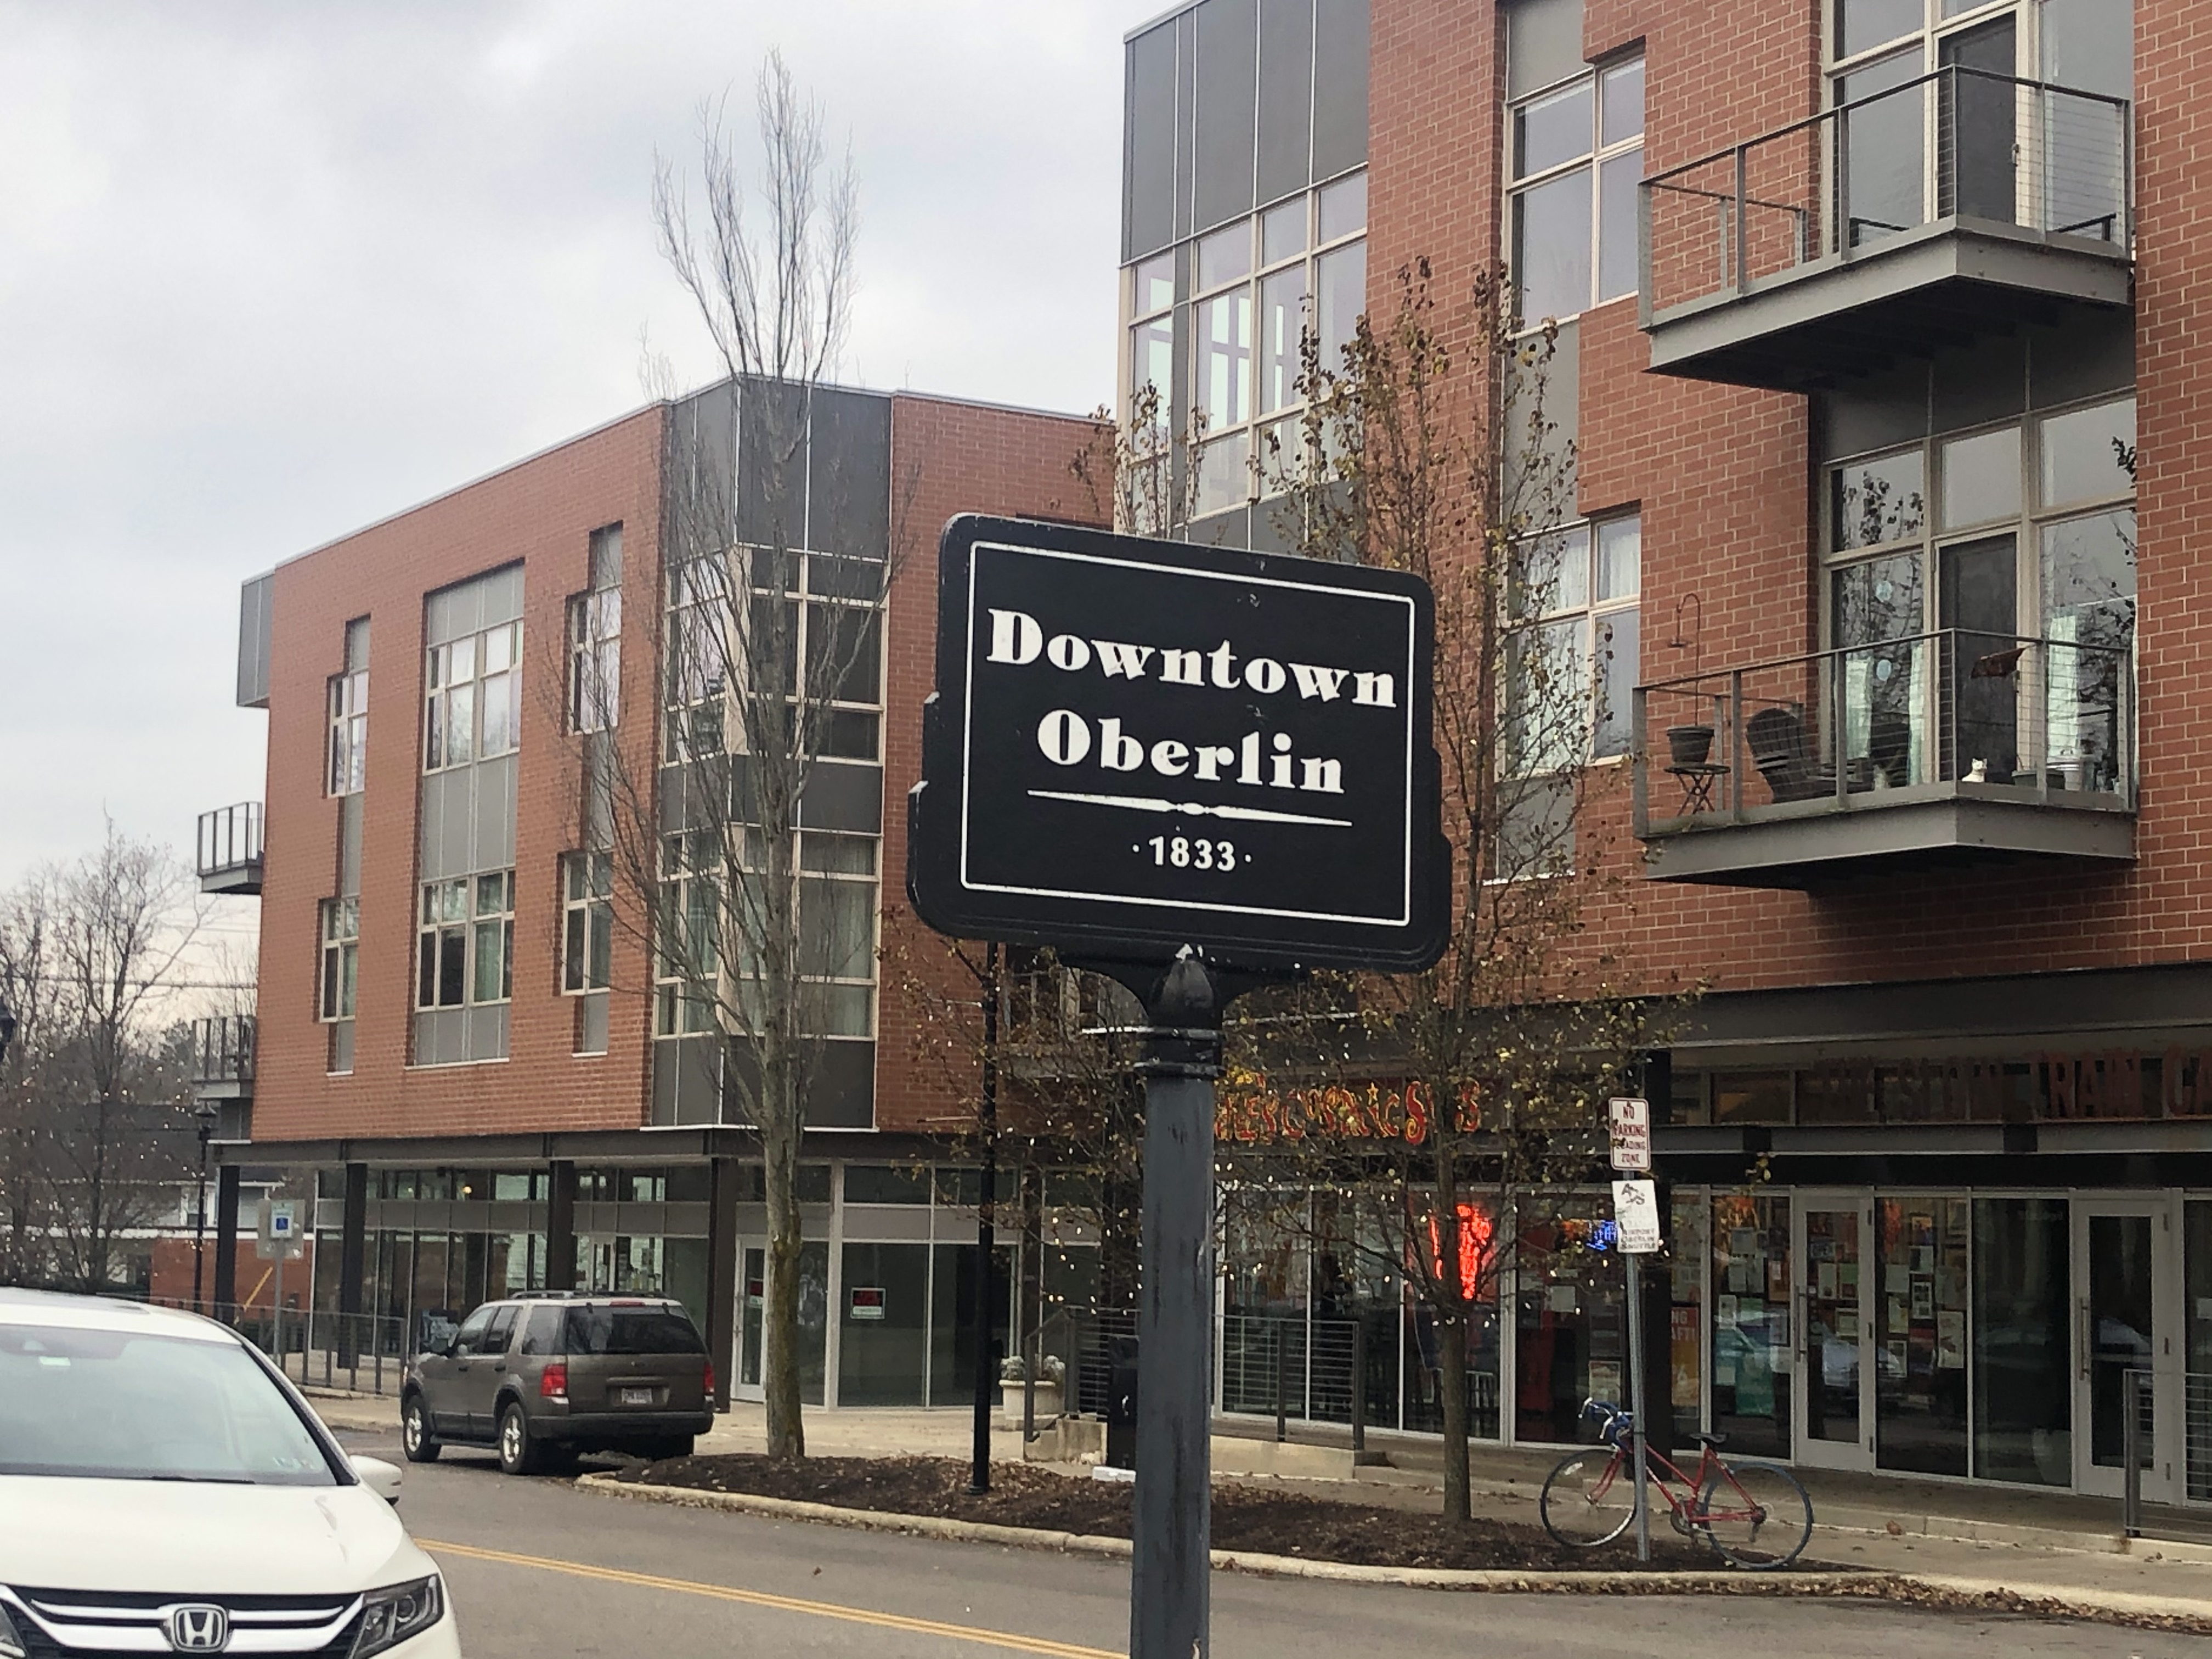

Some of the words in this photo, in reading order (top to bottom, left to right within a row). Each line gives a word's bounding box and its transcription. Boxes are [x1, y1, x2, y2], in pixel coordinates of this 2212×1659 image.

[986, 608, 1397, 708] Downtown
[1037, 710, 1344, 794] Oberlin
[1623, 1107, 1634, 1119] NO
